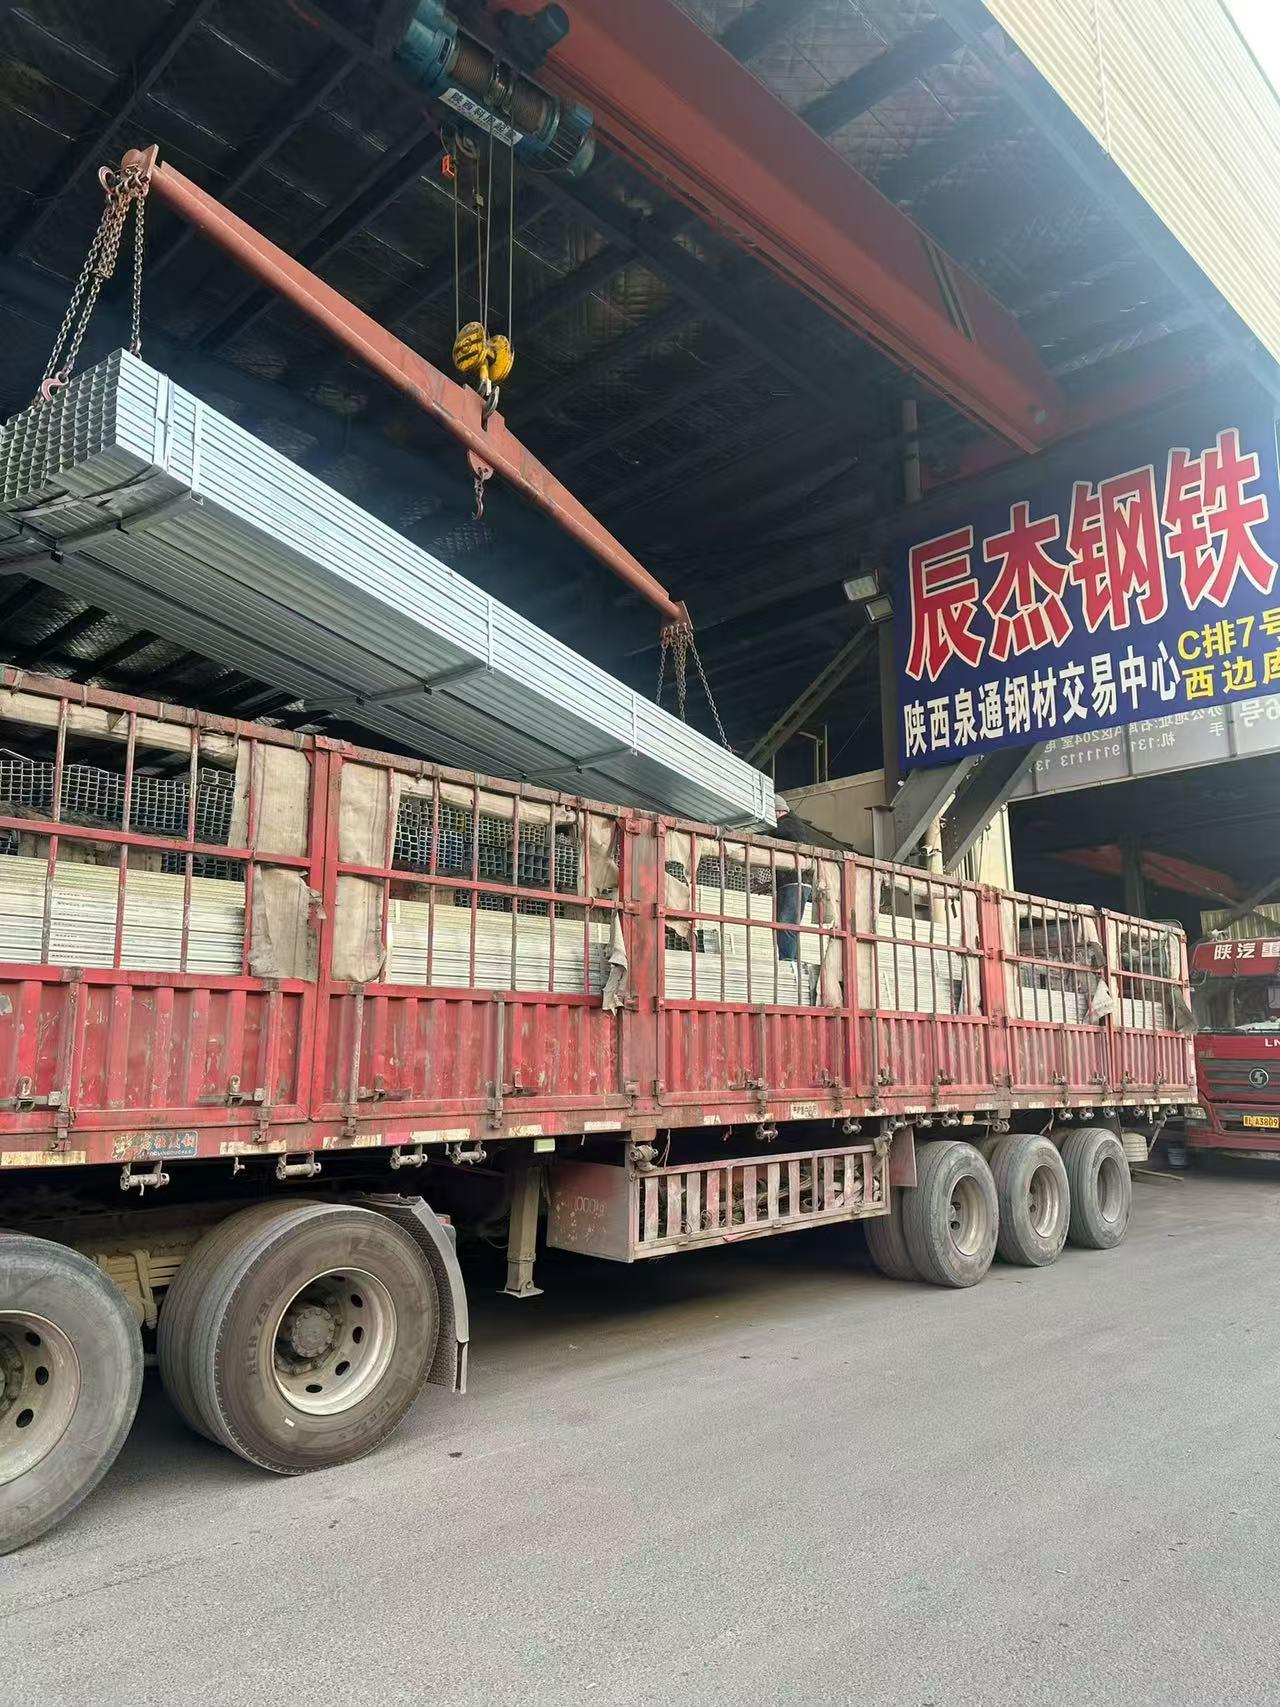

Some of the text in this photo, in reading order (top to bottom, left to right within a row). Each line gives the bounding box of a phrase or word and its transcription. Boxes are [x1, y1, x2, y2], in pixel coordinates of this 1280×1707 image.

[905, 427, 1278, 682] 辰杰钢铁
[904, 640, 1181, 758] 陕西泉通钢材交易中心
